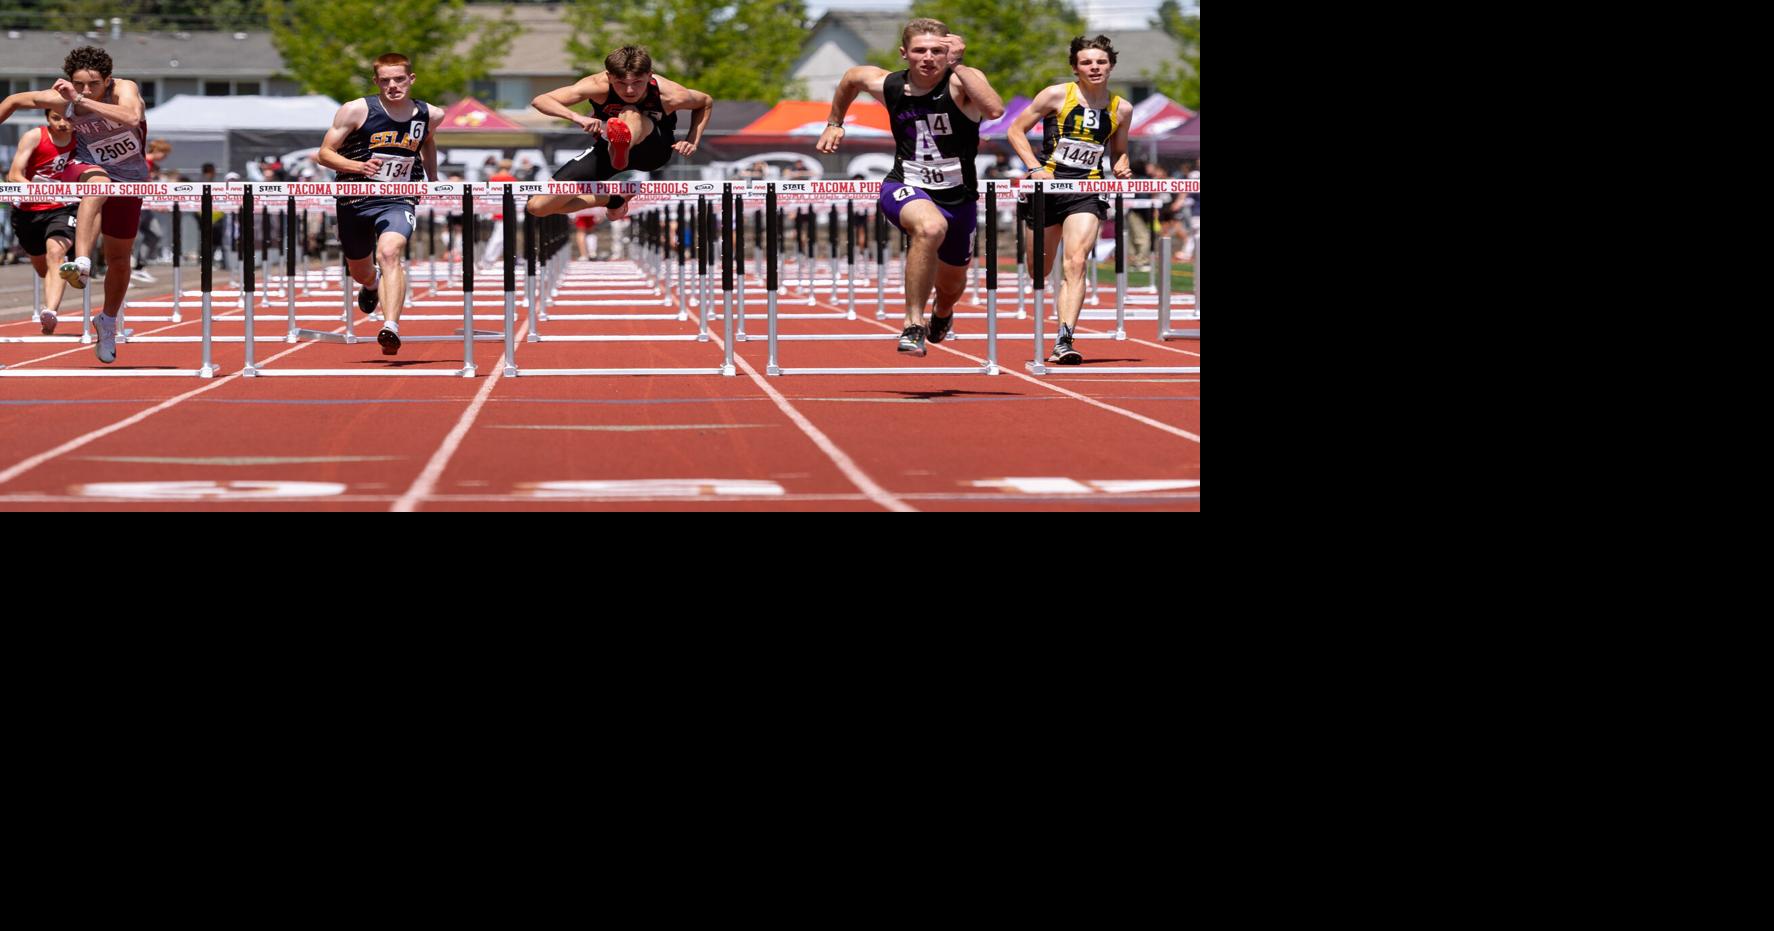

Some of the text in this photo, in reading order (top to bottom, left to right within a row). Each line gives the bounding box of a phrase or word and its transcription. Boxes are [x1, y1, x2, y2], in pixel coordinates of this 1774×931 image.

[934, 115, 948, 134] 4
[1087, 110, 1097, 127] 3
[413, 123, 423, 139] 6
[914, 120, 944, 161] A
[95, 138, 136, 162] 2505
[1063, 146, 1098, 165] 1445
[55, 158, 66, 171] 8
[920, 167, 944, 185] 36
[0, 185, 21, 193] STATE
[27, 184, 72, 195] TACOMA
[76, 184, 115, 195] PUBLIC
[120, 184, 168, 195] SCHOOLS
[287, 184, 332, 195] TACOMA
[336, 184, 376, 195] PUBLIC
[380, 184, 428, 194] SCHOOLS
[548, 183, 592, 194] TACOMA
[596, 183, 636, 194] PUBLIC
[640, 183, 688, 194] SCHOOLS
[811, 182, 855, 193] TACOMA
[860, 182, 881, 193] PUB
[898, 188, 911, 199] 4
[1079, 181, 1123, 192] TACOMA
[1127, 181, 1168, 192] PUBLIC
[1171, 181, 1200, 192] SCHO
